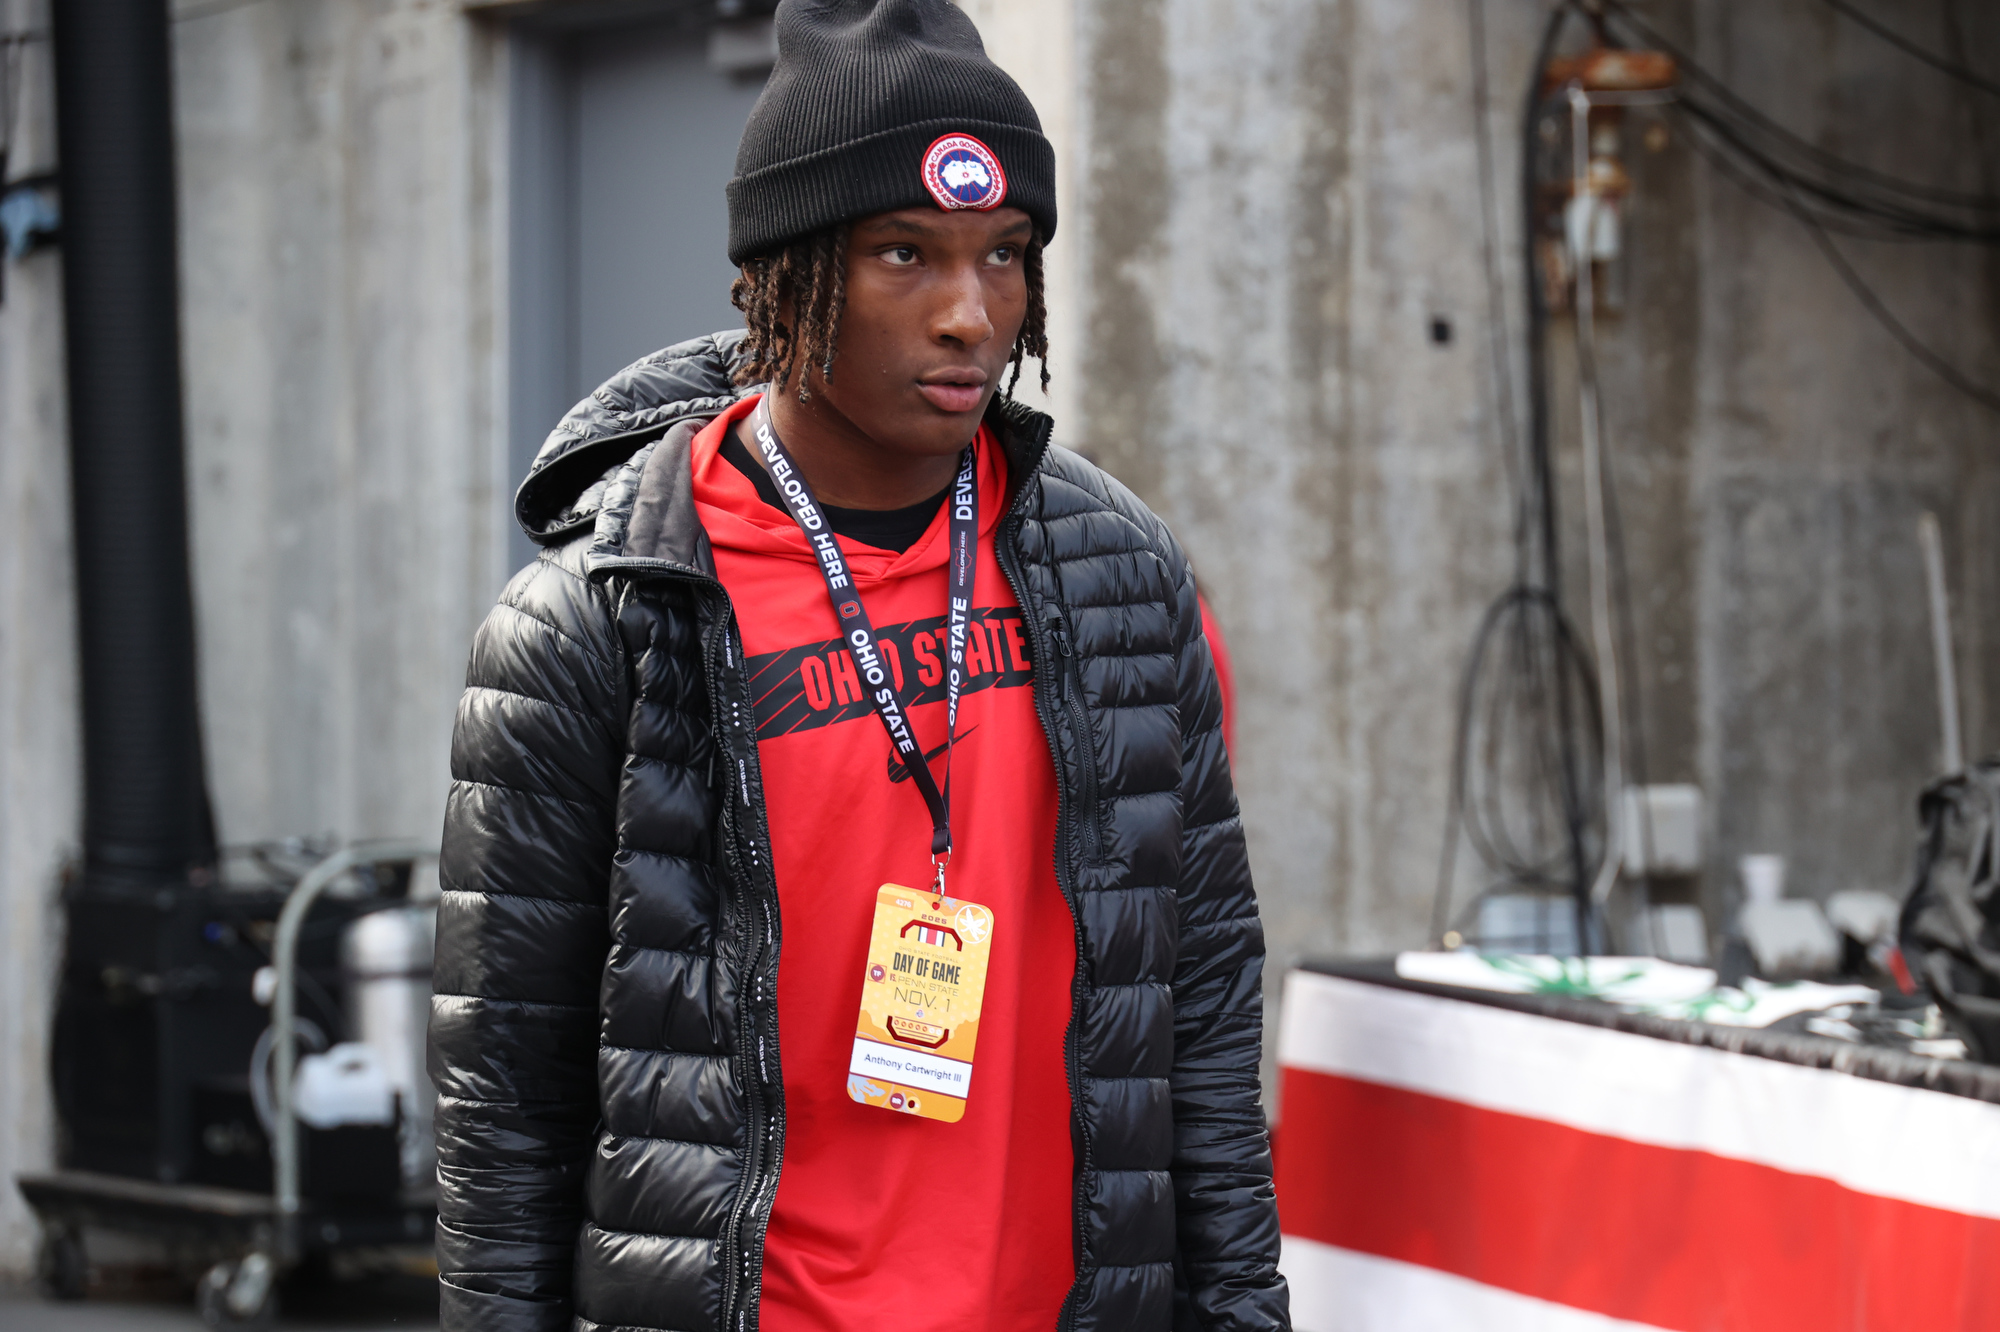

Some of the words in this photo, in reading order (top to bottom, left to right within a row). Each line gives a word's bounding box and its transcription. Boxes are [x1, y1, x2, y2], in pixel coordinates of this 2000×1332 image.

[932, 141, 958, 162] CANADA
[959, 141, 984, 156] GOOSE
[756, 423, 822, 530] DEVELOPED
[813, 533, 848, 590] HERE
[951, 597, 967, 665] STATE
[800, 638, 904, 711] OHO
[851, 629, 884, 685] OHIO
[876, 688, 915, 754] STATE
[949, 668, 960, 727] OHIO
[921, 913, 947, 924] 2025
[893, 952, 914, 974] DAY
[916, 958, 930, 977] OF
[931, 961, 961, 985] GAME
[894, 986, 937, 1010] NOV.
[946, 998, 950, 1012] 1
[898, 975, 926, 989] PENN
[929, 982, 959, 997] STATE
[864, 1053, 902, 1070] Anthony
[905, 1062, 951, 1080] Cartwright
[954, 1073, 962, 1082] III
